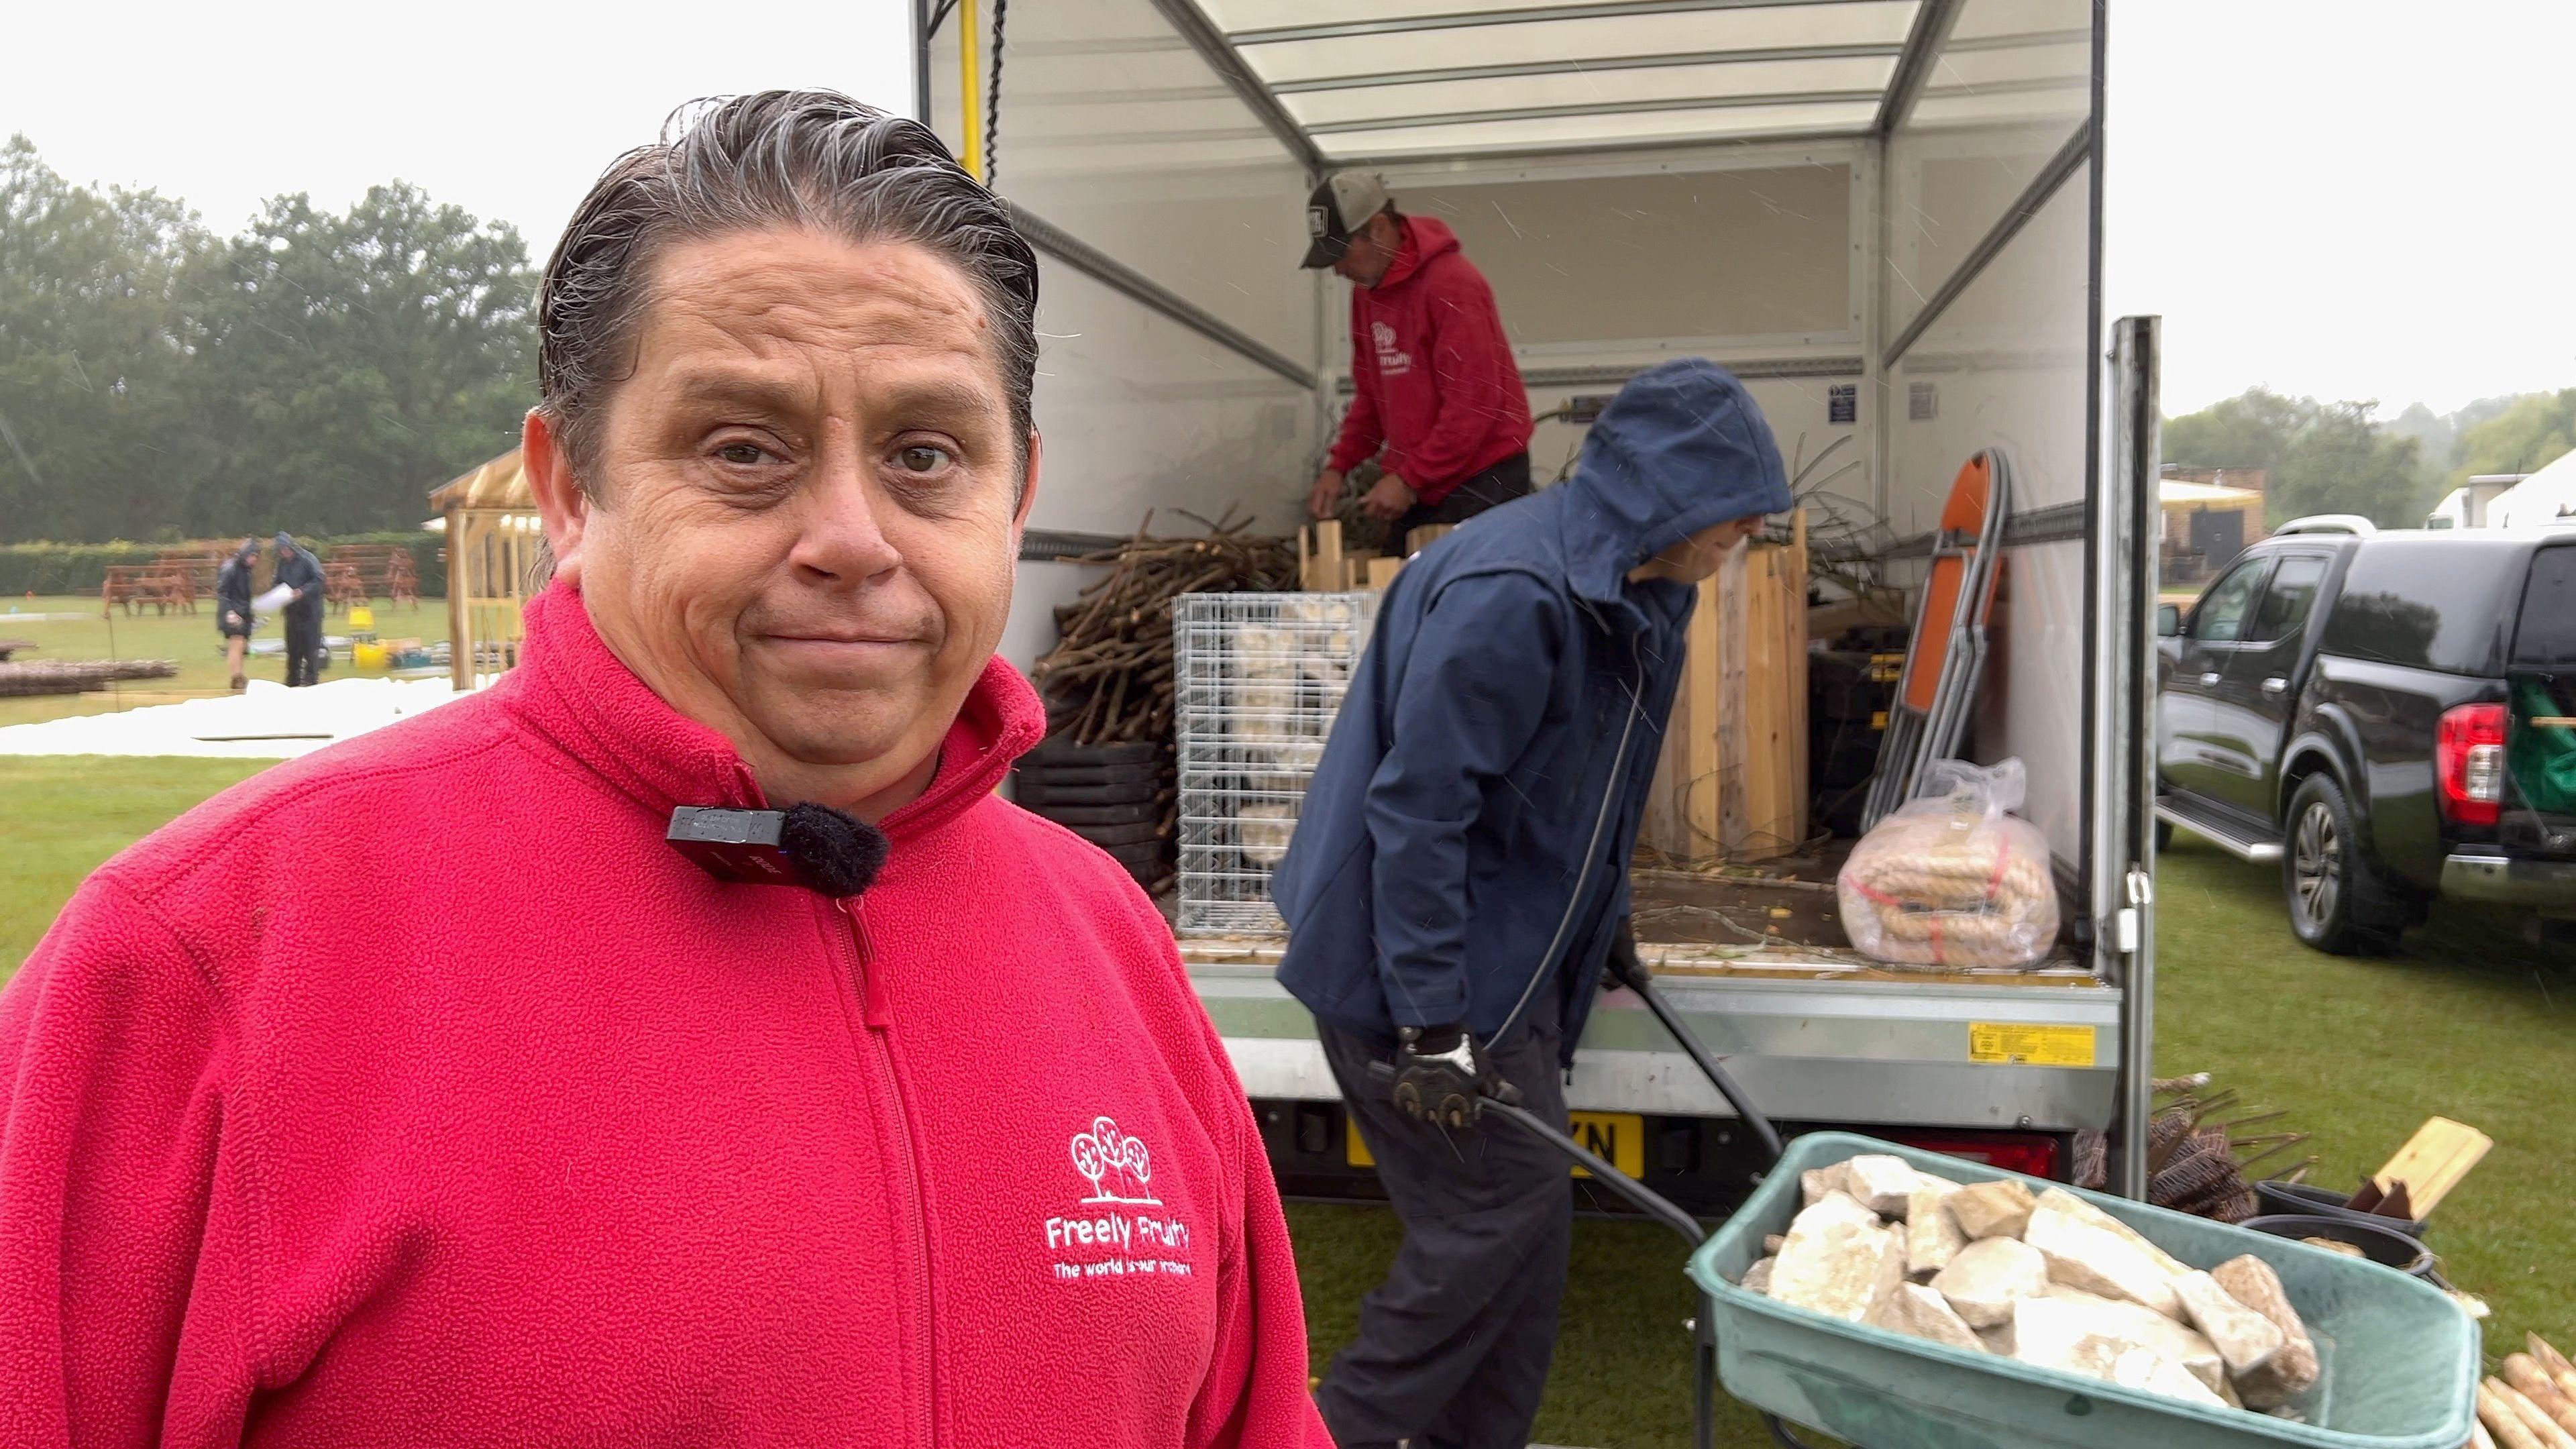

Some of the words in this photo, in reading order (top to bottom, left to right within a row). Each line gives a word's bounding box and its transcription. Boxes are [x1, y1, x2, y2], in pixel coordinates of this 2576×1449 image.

[1046, 1212, 1130, 1251] Freely
[1053, 1262, 1081, 1279] The
[1085, 1257, 1124, 1276] world
